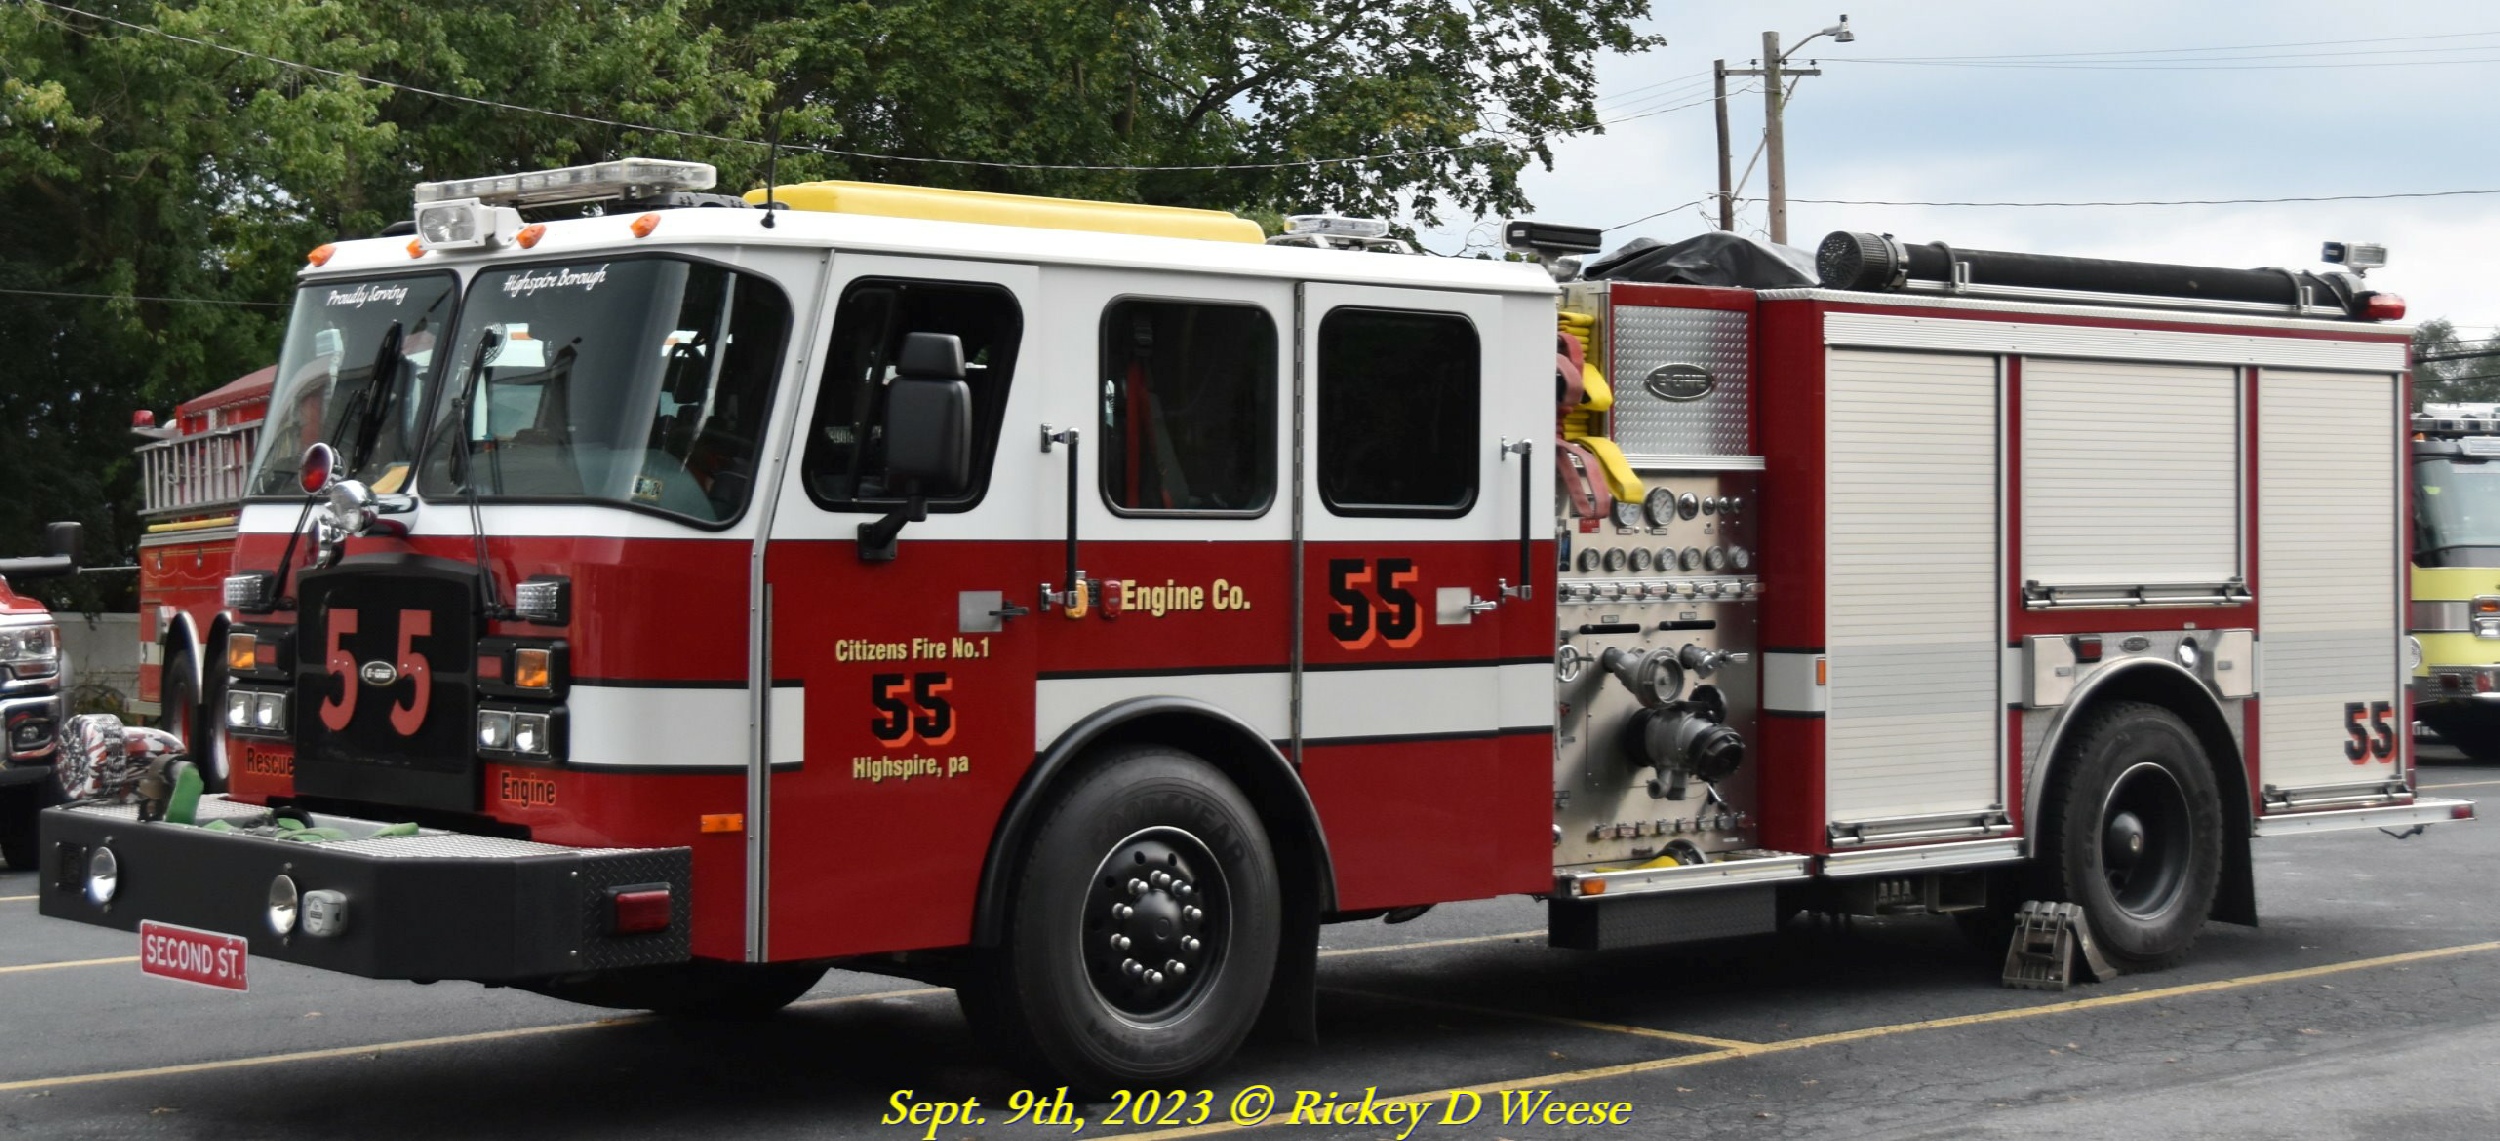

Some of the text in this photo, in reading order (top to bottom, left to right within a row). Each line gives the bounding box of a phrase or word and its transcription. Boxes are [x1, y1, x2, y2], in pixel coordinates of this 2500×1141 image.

[326, 284, 408, 308] Proudly Serving
[503, 263, 610, 298] Highspire Borough
[1121, 579, 1251, 617] Engine Co.
[1328, 558, 1423, 650] 55
[835, 636, 989, 662] Citizens Fire No.1
[871, 671, 957, 748] 55
[2343, 700, 2398, 766] 55
[246, 747, 295, 777] Rescue
[853, 754, 970, 782] Highspire, pa
[500, 771, 557, 808] Engine
[146, 933, 243, 981] SECOND ST.
